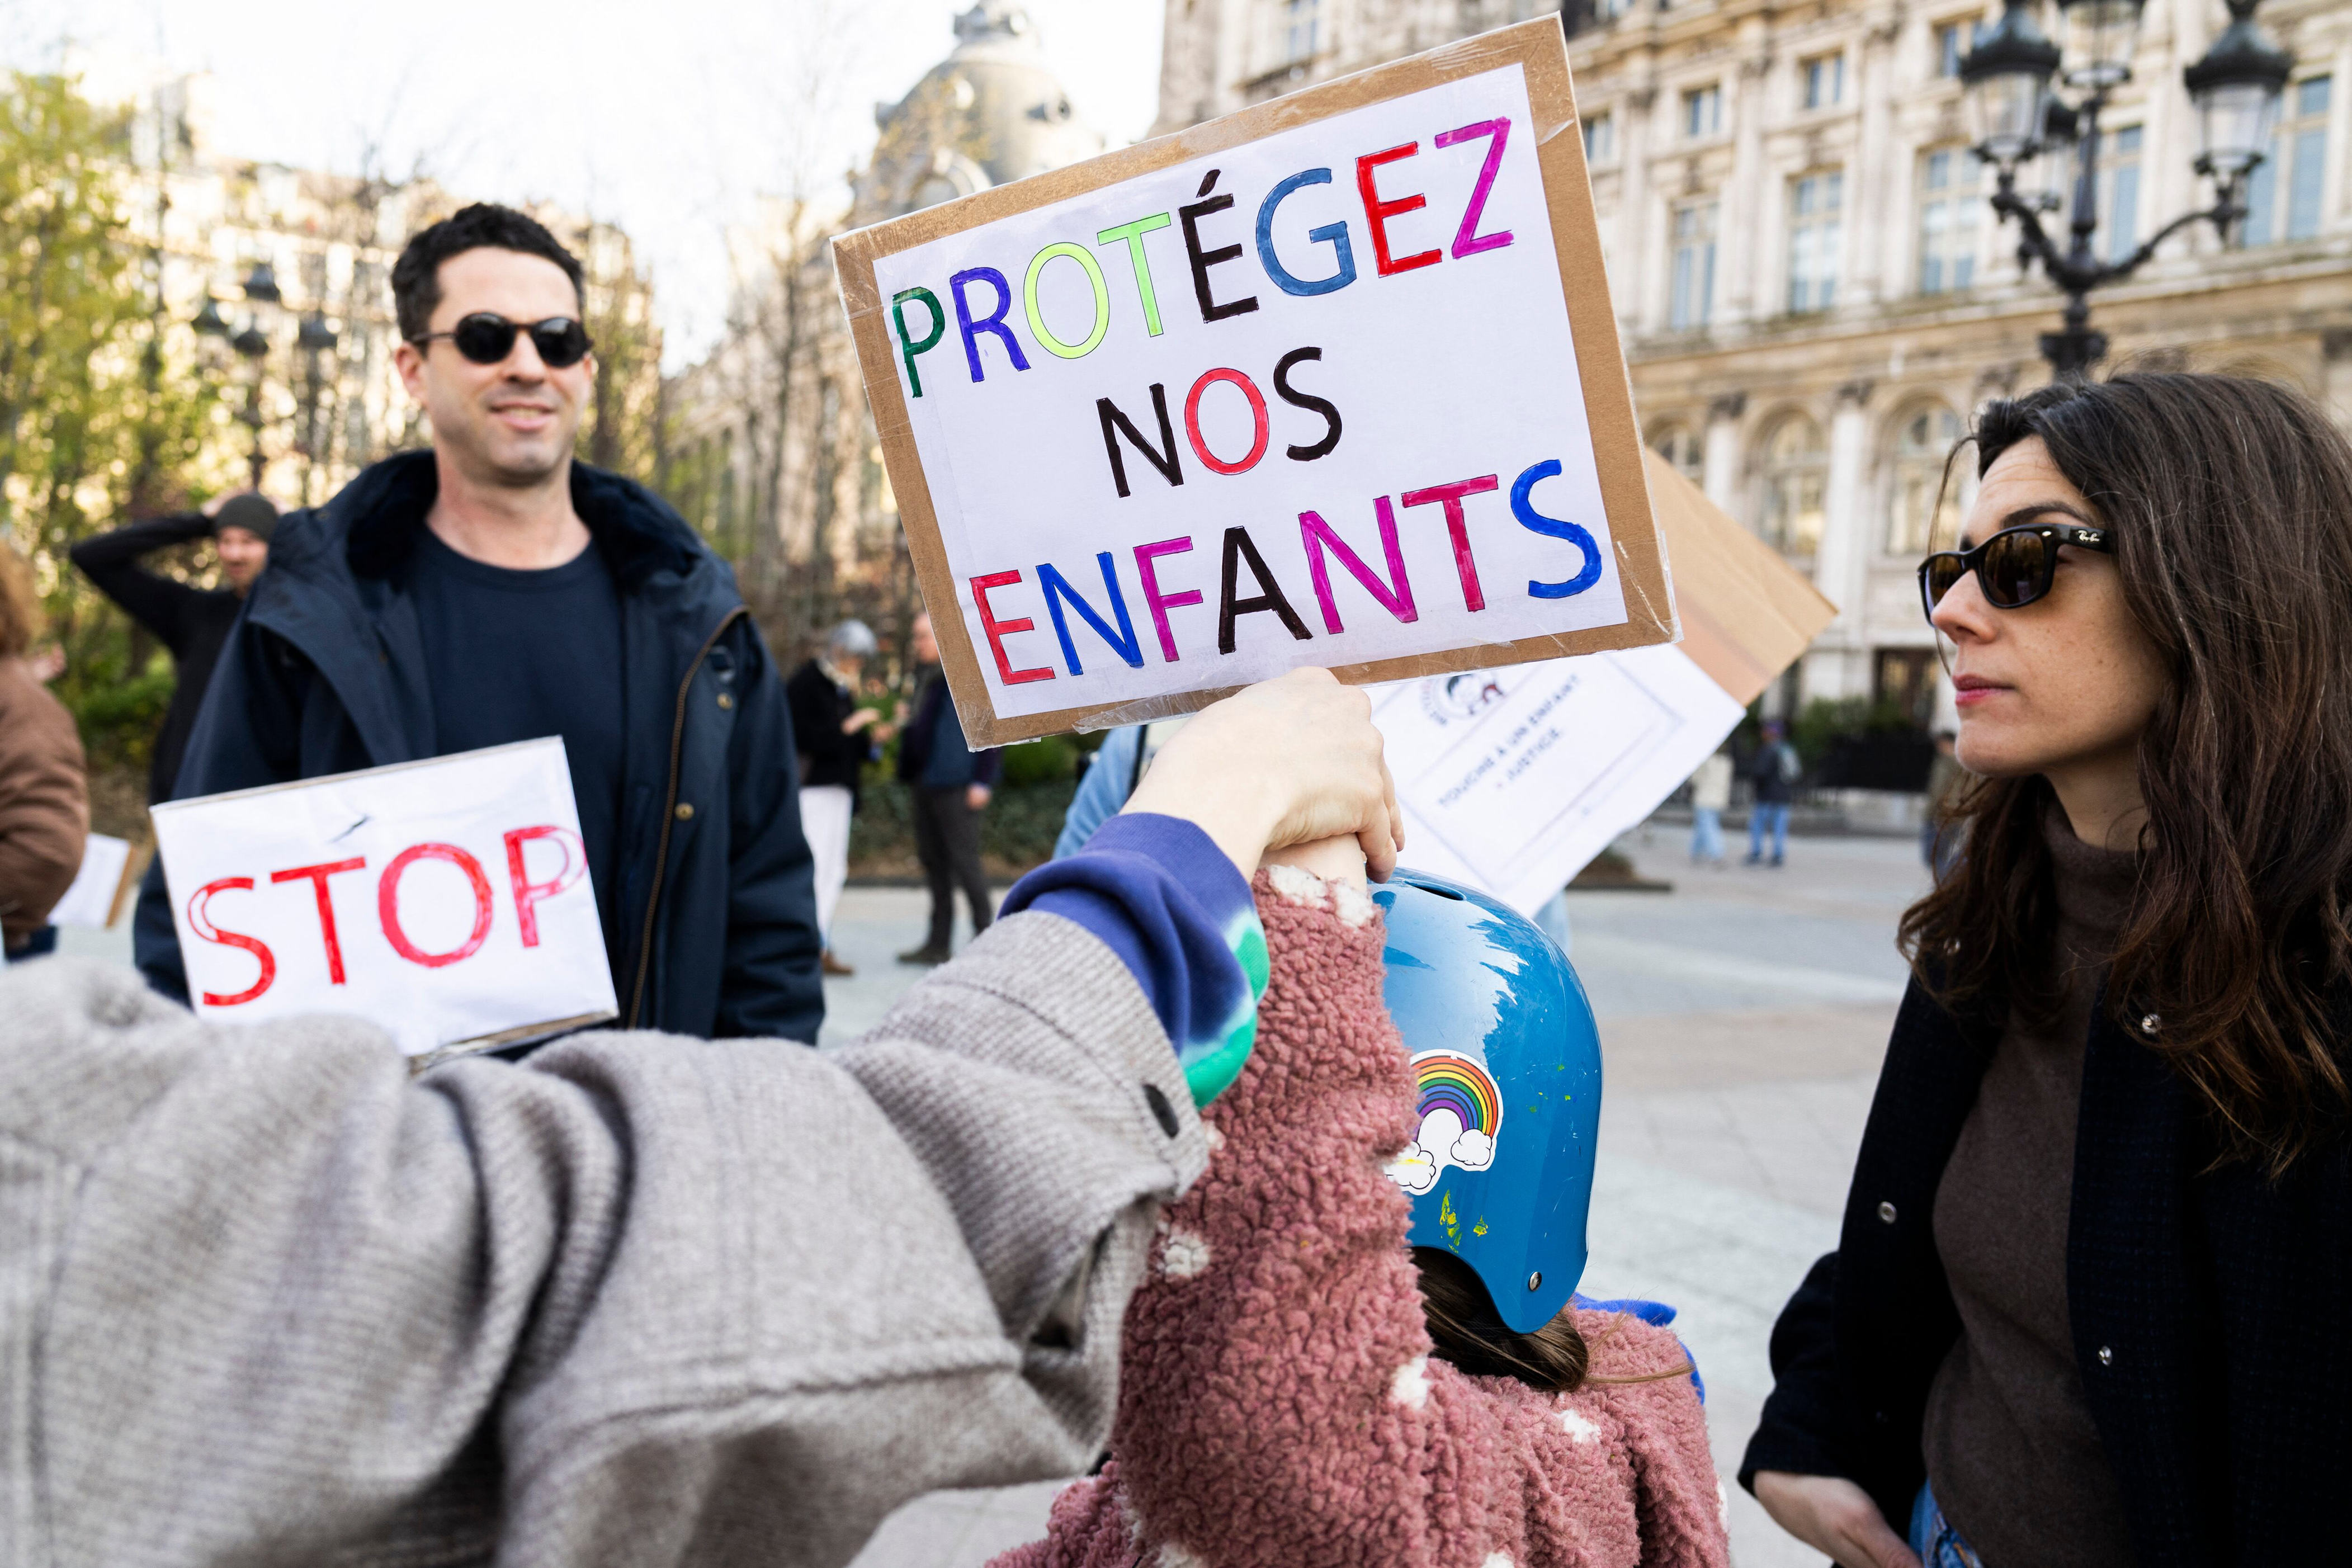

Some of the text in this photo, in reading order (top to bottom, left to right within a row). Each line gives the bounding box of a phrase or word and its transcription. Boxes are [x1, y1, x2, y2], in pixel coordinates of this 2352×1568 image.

[892, 117, 1514, 398] PROTÉGEZ
[1096, 346, 1342, 497] NOS
[969, 459, 1603, 685] ENFANTS
[187, 825, 587, 1007] STOP
